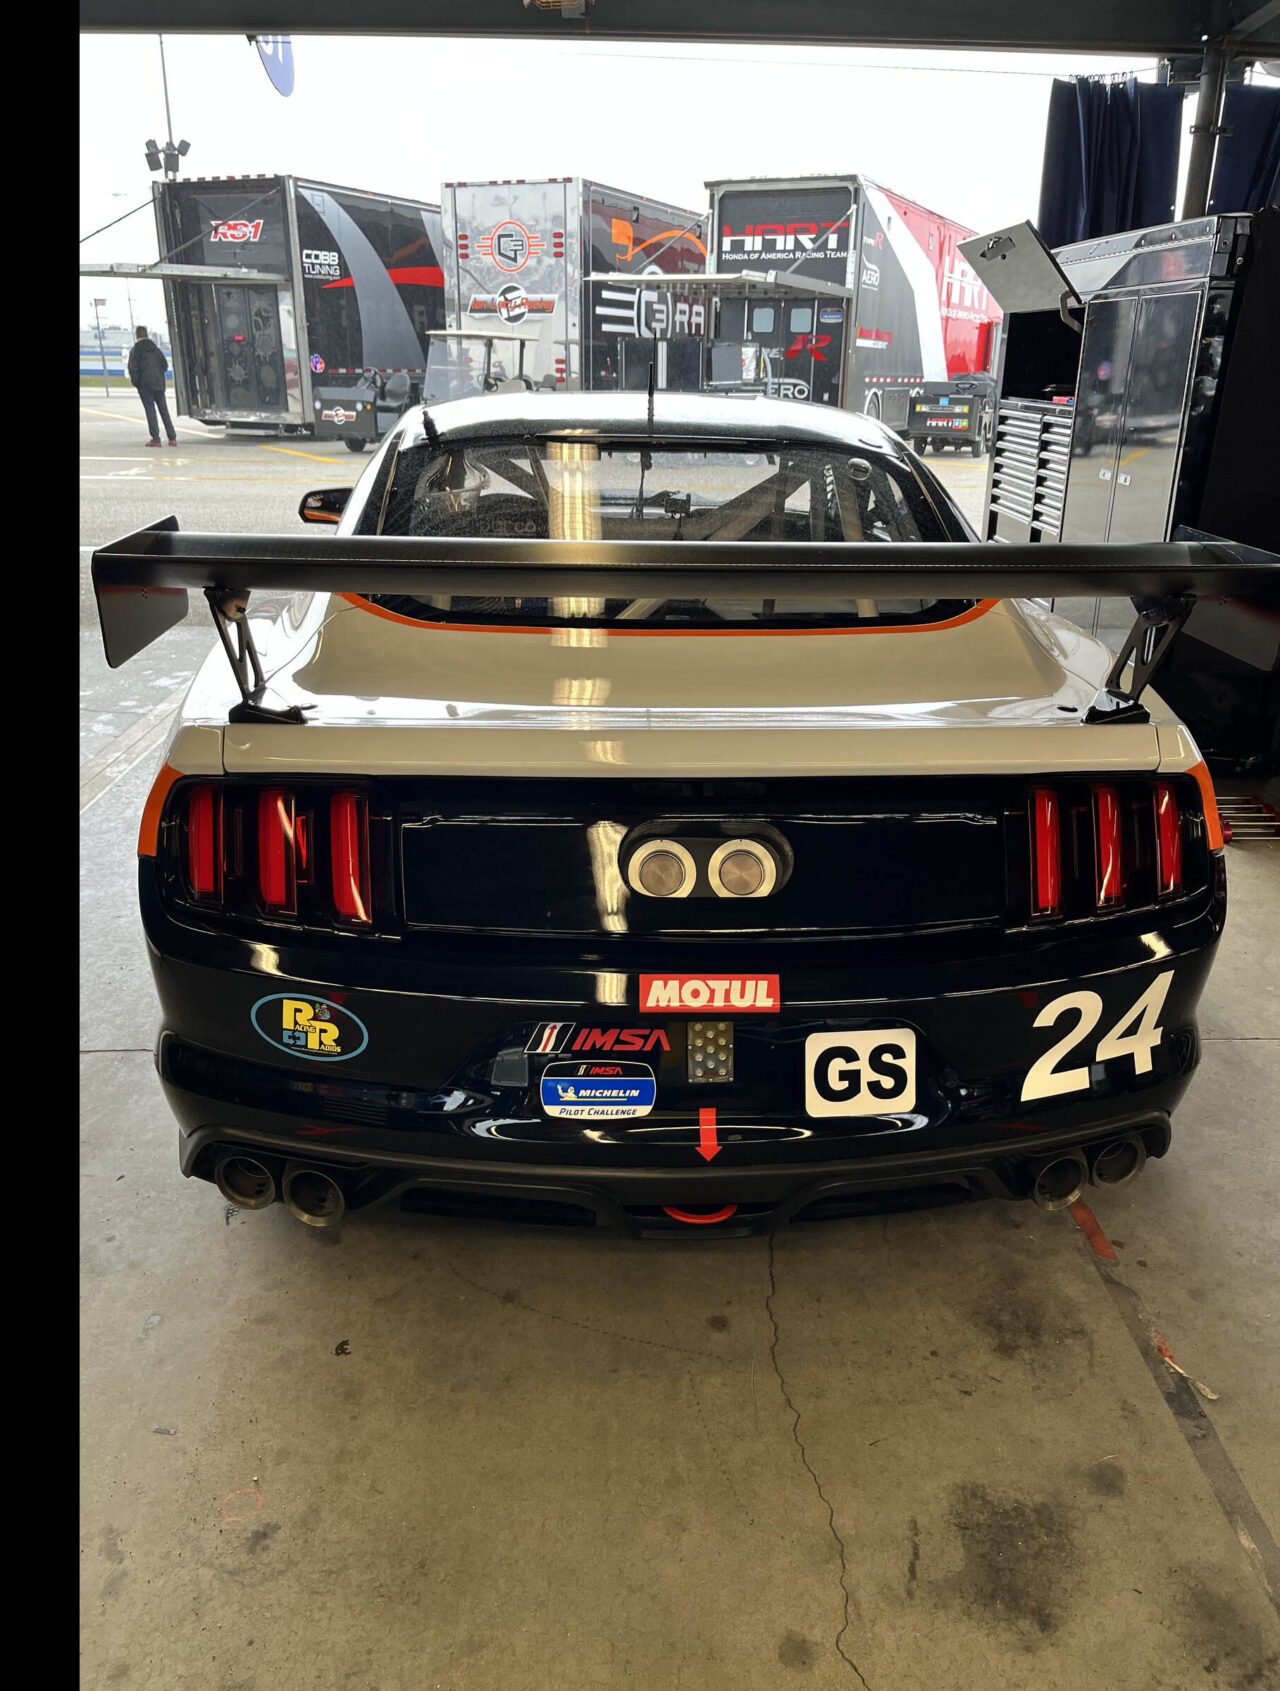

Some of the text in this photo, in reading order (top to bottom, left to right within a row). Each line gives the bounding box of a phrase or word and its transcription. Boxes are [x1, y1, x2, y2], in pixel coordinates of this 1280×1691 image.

[210, 219, 264, 242] RS1
[722, 222, 849, 251] HART
[303, 249, 338, 265] COBB
[722, 252, 748, 260] HONDA
[760, 252, 794, 260] AMERICA
[795, 251, 825, 260] RACING
[826, 251, 848, 259] TEAM
[303, 263, 341, 276] TUNING
[861, 268, 880, 286] AERO
[471, 296, 495, 310] Ian
[520, 297, 556, 312] Racing
[646, 979, 775, 1009] MOTUL
[572, 1028, 671, 1052] IMSA
[1021, 970, 1175, 1102] 24
[589, 1066, 623, 1076] IMSA
[813, 1044, 909, 1103] GS
[578, 1088, 640, 1098] MICHELIN
[559, 1106, 638, 1117] PILOT CHALLENGE
